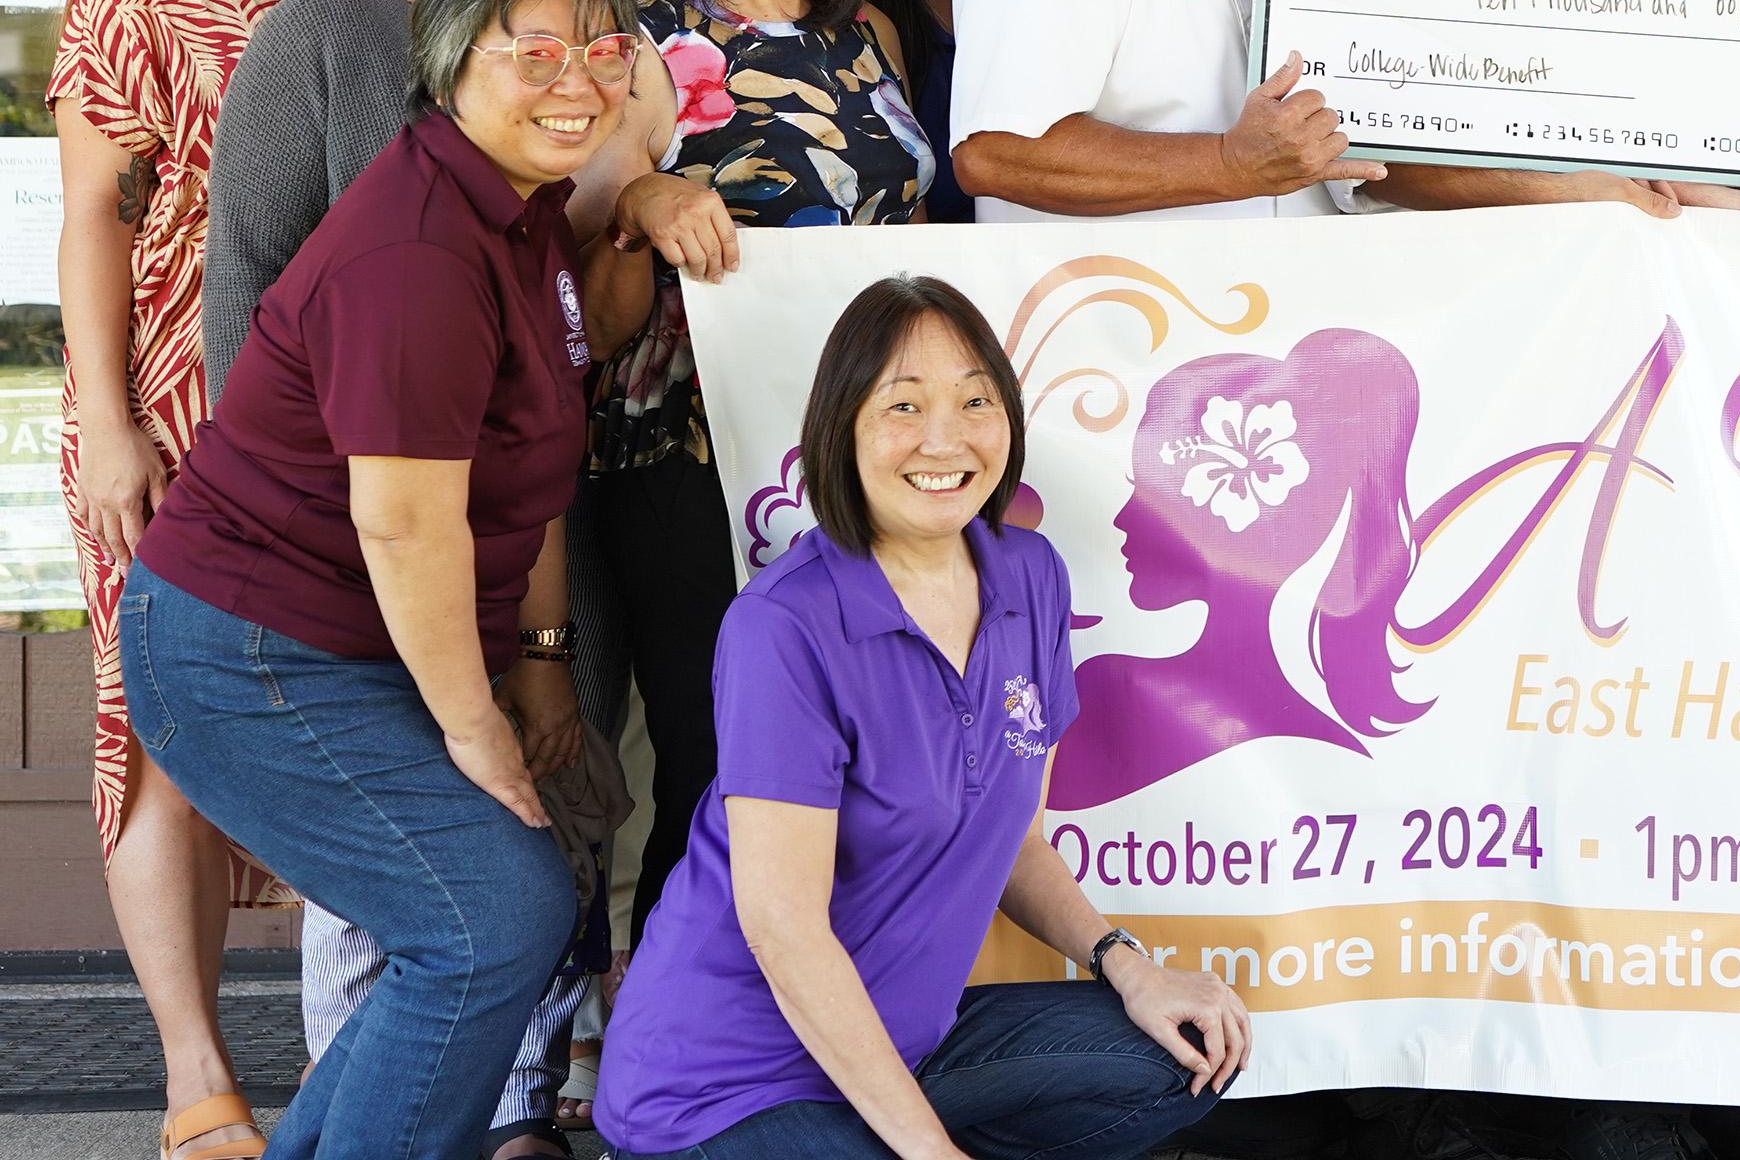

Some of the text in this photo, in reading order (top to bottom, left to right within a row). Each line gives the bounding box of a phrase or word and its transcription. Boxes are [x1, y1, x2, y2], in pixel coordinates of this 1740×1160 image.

[1302, 60, 1326, 76] OR
[1388, 314, 1685, 653] A
[1504, 654, 1650, 737] East
[1050, 821, 1277, 888] October
[1290, 813, 1377, 885] 27,
[1399, 804, 1544, 871] 2024
[1202, 938, 1373, 989] more
